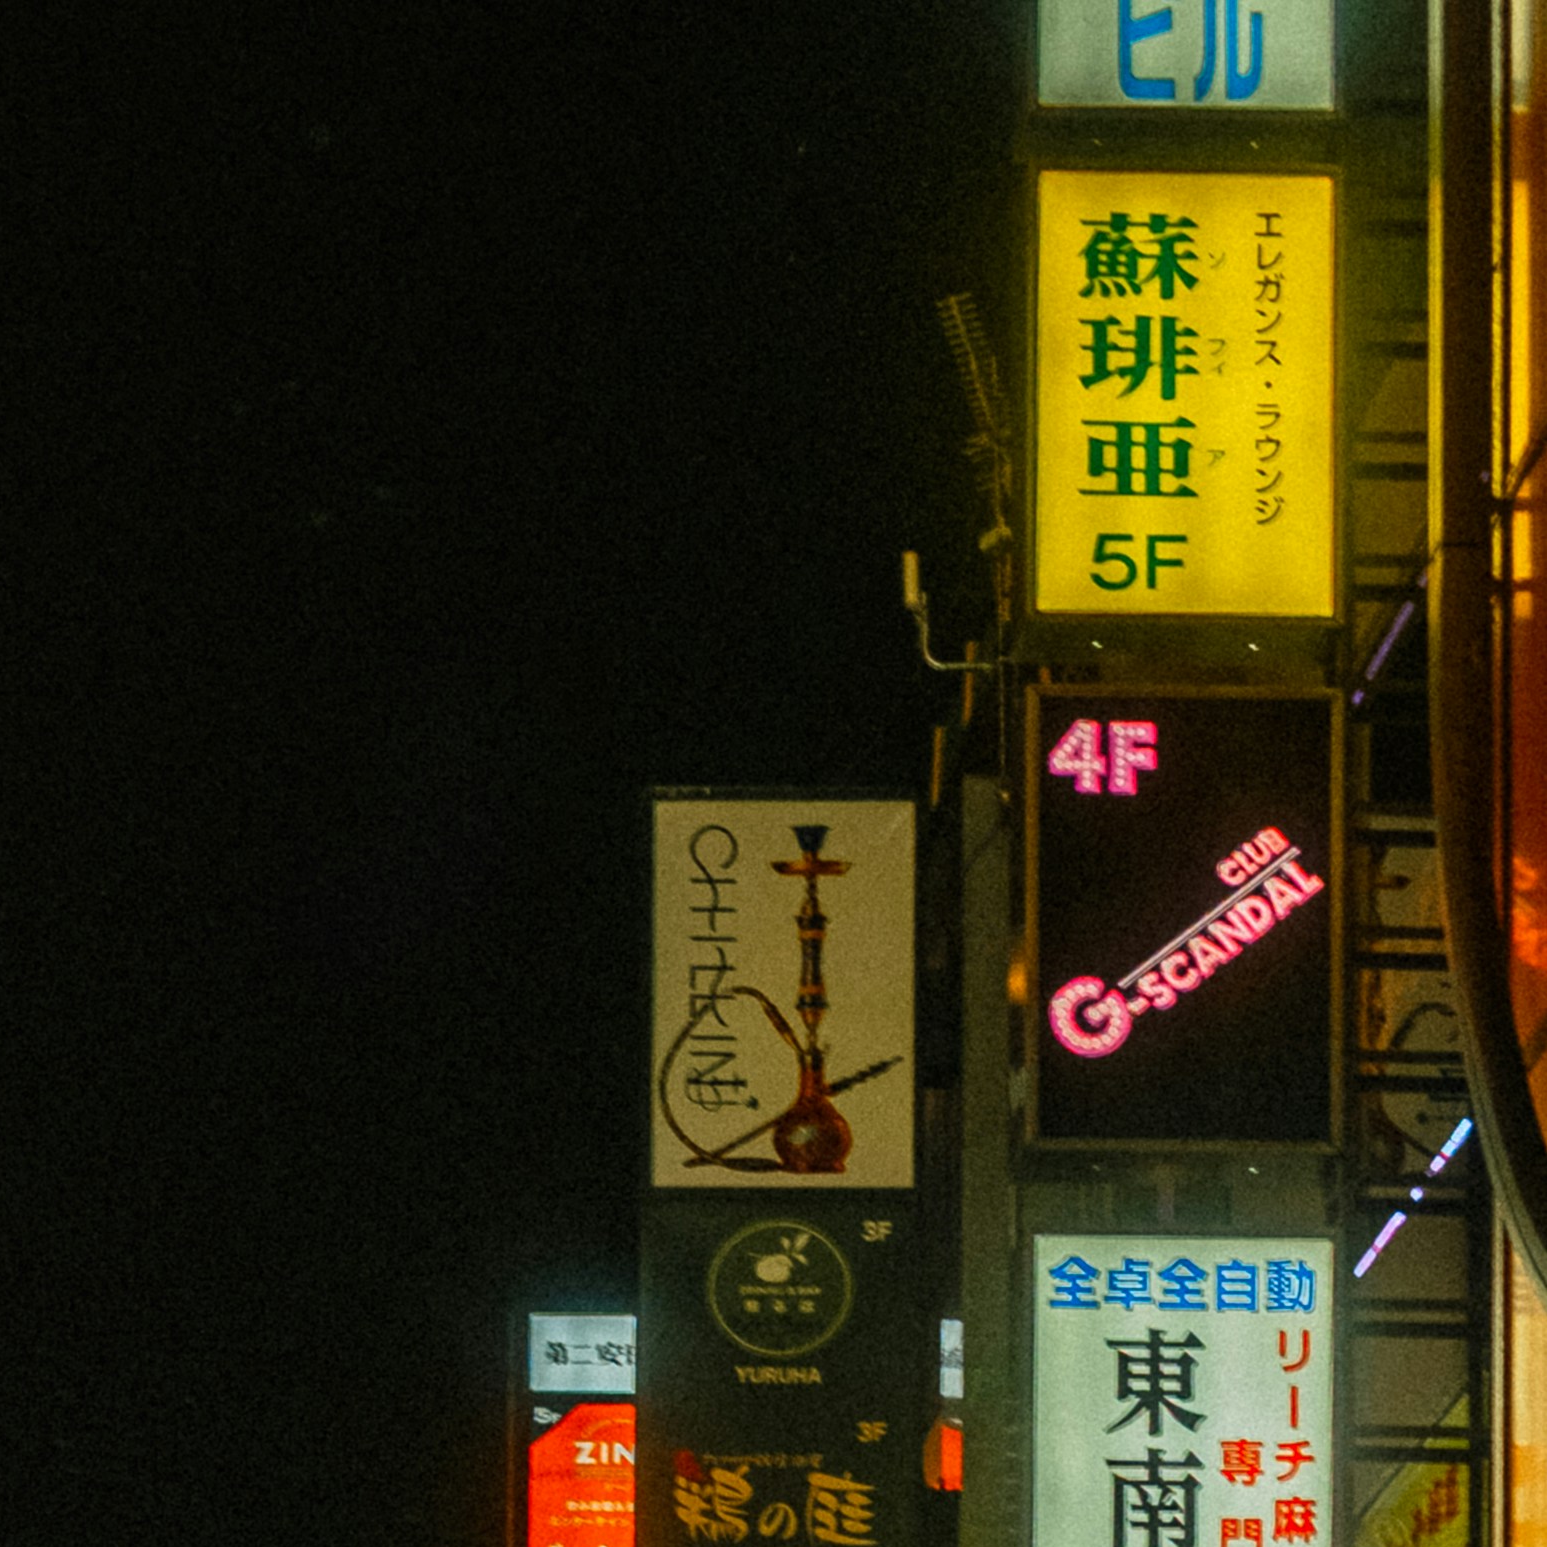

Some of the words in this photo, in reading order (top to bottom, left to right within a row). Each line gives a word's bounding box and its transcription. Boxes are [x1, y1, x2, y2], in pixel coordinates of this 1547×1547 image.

[1078, 211, 1200, 499] 蘇琲亜
[1254, 212, 1285, 526] エレガンス・ラウンジ
[1089, 532, 1189, 591] 5F
[1048, 719, 1159, 796] 4F
[1215, 825, 1292, 887] CLUB
[1048, 858, 1326, 1060] G-SCANDAL
[862, 1220, 892, 1242] 3F
[1049, 1255, 1318, 1314] 全卓全自動
[735, 1365, 823, 1386] YURUHA
[857, 1421, 888, 1443] 3F
